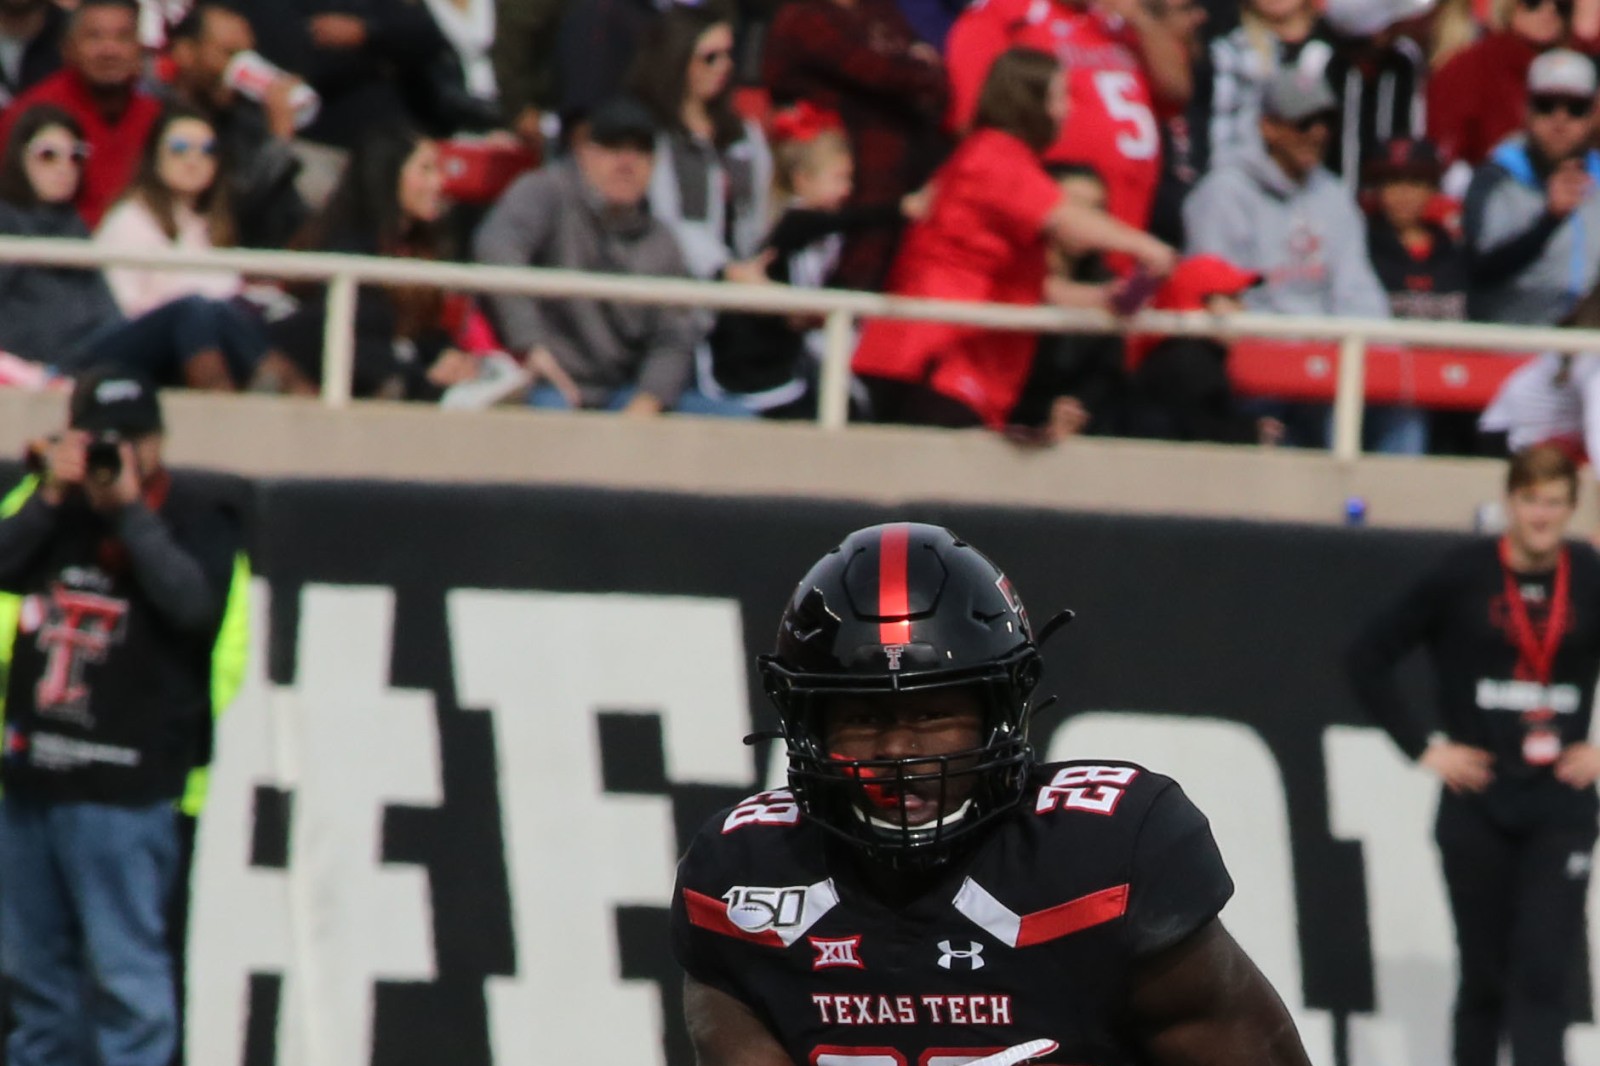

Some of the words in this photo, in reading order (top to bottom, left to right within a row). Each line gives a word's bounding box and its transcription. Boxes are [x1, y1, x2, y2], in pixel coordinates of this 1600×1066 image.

[1035, 765, 1139, 816] 28
[725, 887, 807, 931] 150
[809, 936, 864, 969] XII
[811, 994, 918, 1025] TEXAS
[920, 994, 1013, 1025] TECH
